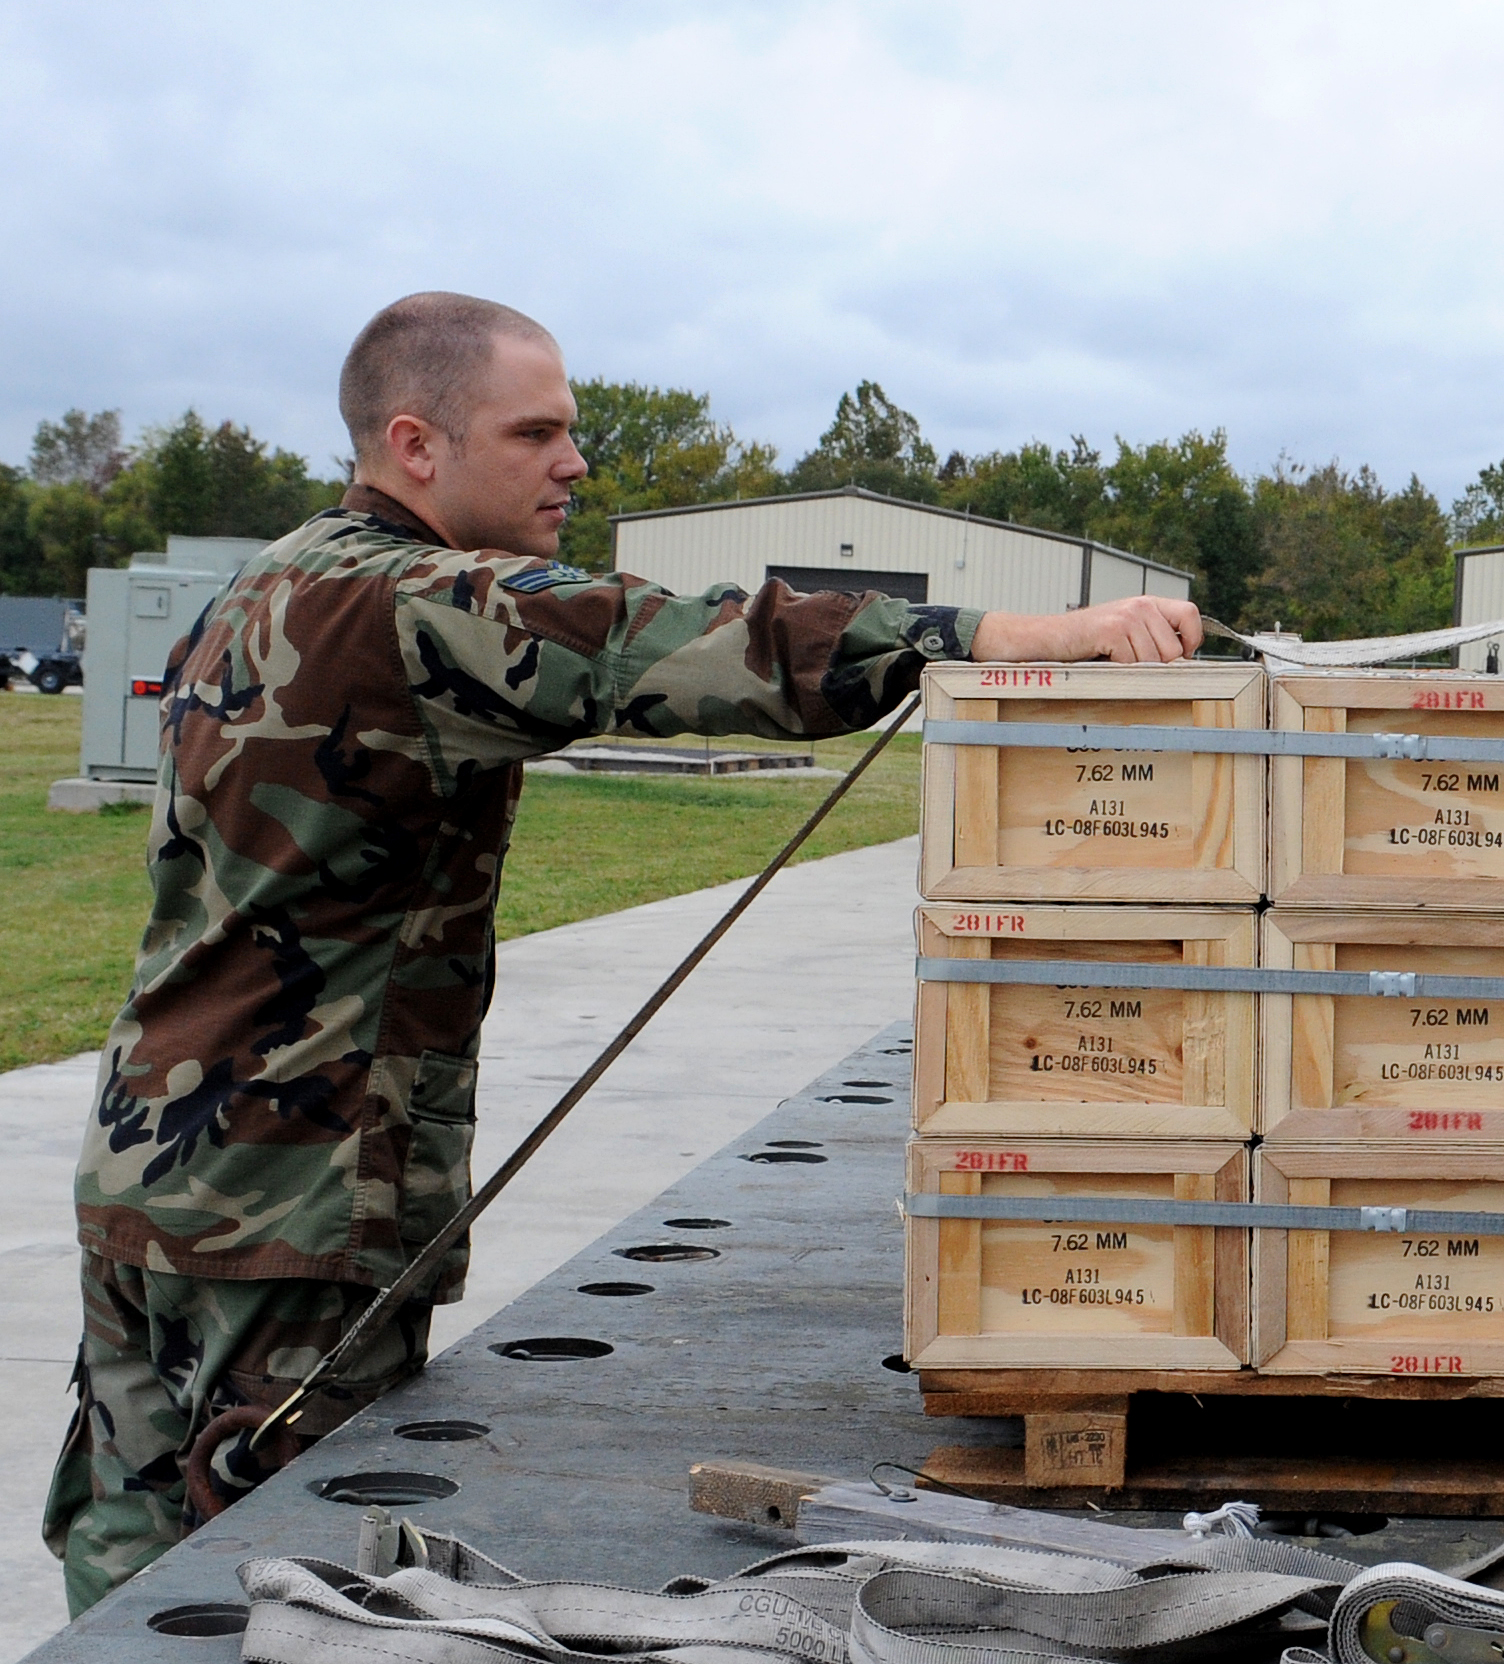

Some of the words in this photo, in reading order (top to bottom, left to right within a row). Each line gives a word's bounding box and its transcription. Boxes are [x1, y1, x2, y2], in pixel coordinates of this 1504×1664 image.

[981, 669, 1054, 687] 281FR
[1413, 691, 1485, 709] 281FR
[1076, 765, 1113, 782] 7.62
[1122, 764, 1153, 781] MM
[1422, 774, 1459, 791] 7.62
[1467, 774, 1498, 791] MM
[1090, 800, 1124, 816] A131
[1435, 809, 1469, 825] A131
[1045, 819, 1168, 838] LC-08F603L945
[954, 914, 1025, 932] 281FR
[1065, 1001, 1102, 1018] 7.62
[1111, 1001, 1141, 1018] MM
[1410, 1009, 1448, 1026] 7.62
[1457, 1008, 1488, 1025] MM
[1078, 1036, 1112, 1052] A131
[1425, 1044, 1459, 1060] A131
[1029, 1055, 1156, 1074] LC-08F603L945
[1382, 1063, 1503, 1081] LC-08F603L945
[1408, 1111, 1483, 1131] 281FR
[955, 1152, 1029, 1173] 281FR
[1052, 1234, 1088, 1252] 7.62
[1096, 1232, 1127, 1250] MM
[1402, 1240, 1439, 1257] 7.62
[1448, 1239, 1478, 1256] MM
[1065, 1269, 1099, 1284] A131
[1415, 1274, 1449, 1290] A131
[1022, 1288, 1144, 1305] LC-08F603L945
[1368, 1293, 1493, 1312] LC-08F603L945
[1391, 1356, 1463, 1373] 281FR
[775, 1627, 825, 1656] 5000
